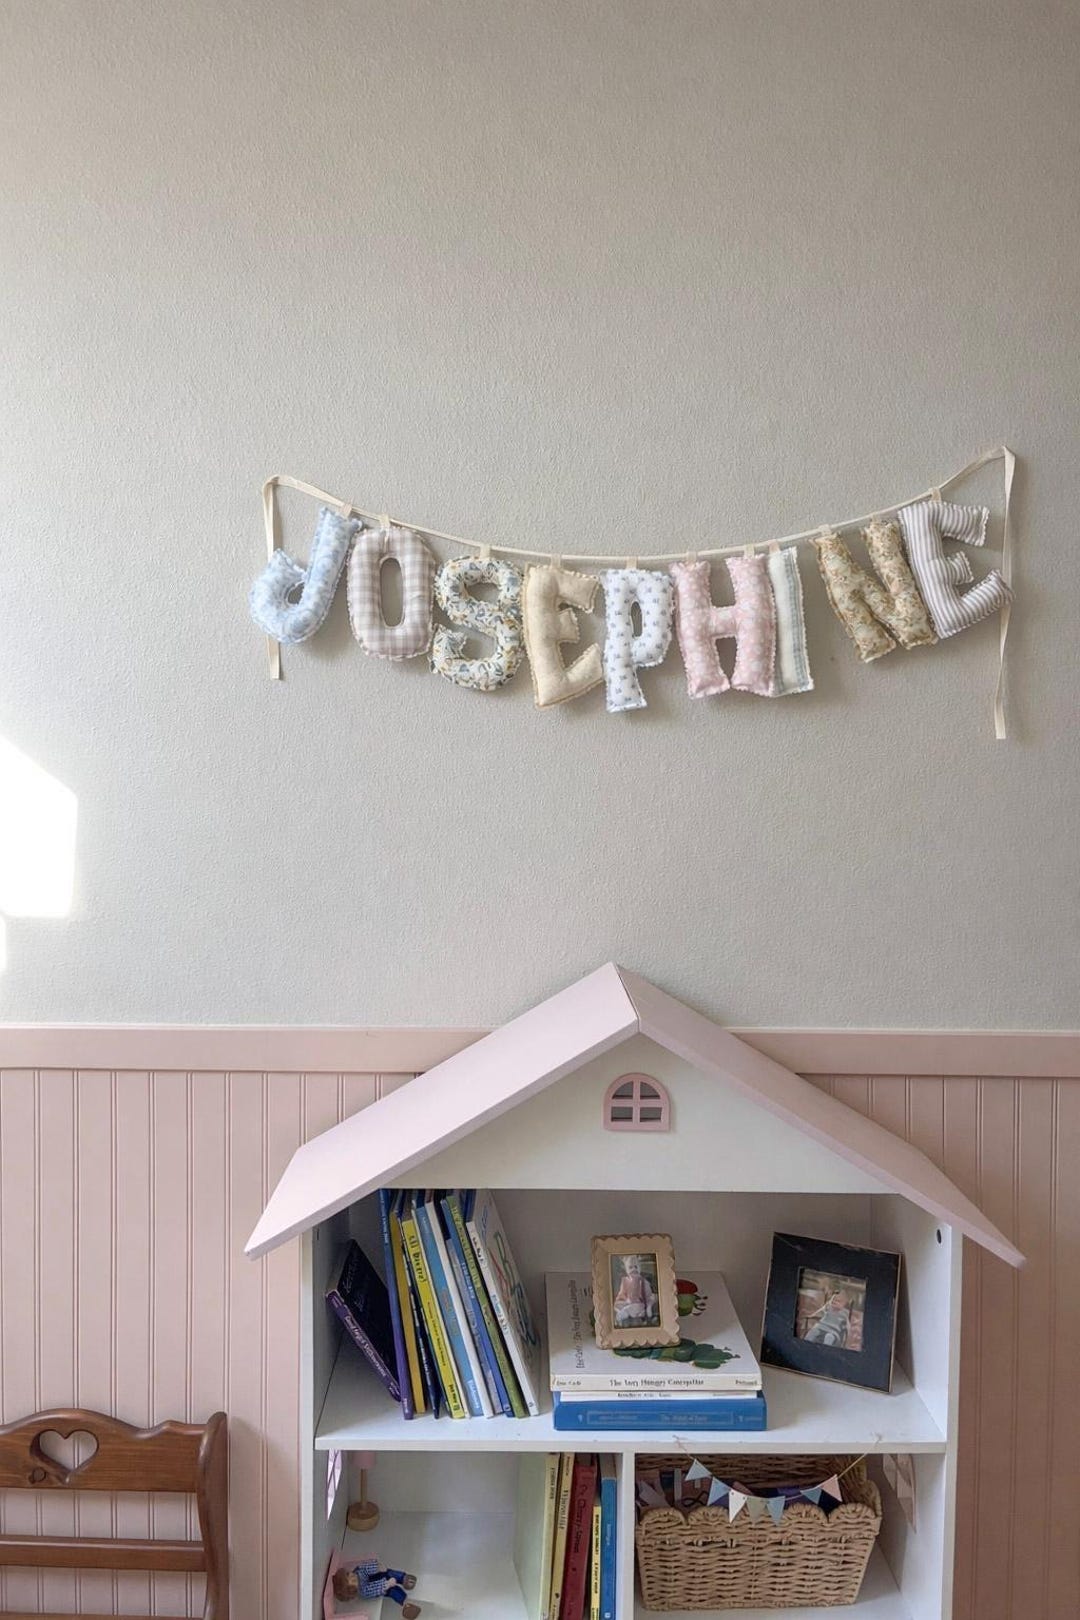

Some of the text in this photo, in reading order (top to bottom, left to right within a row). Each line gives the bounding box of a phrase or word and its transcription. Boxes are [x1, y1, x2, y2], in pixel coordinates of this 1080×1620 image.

[248, 500, 1015, 713] JOSEPHINE
[624, 1379, 638, 1388] Very
[641, 1379, 665, 1388] Hungry
[667, 1379, 704, 1387] Caterpillar
